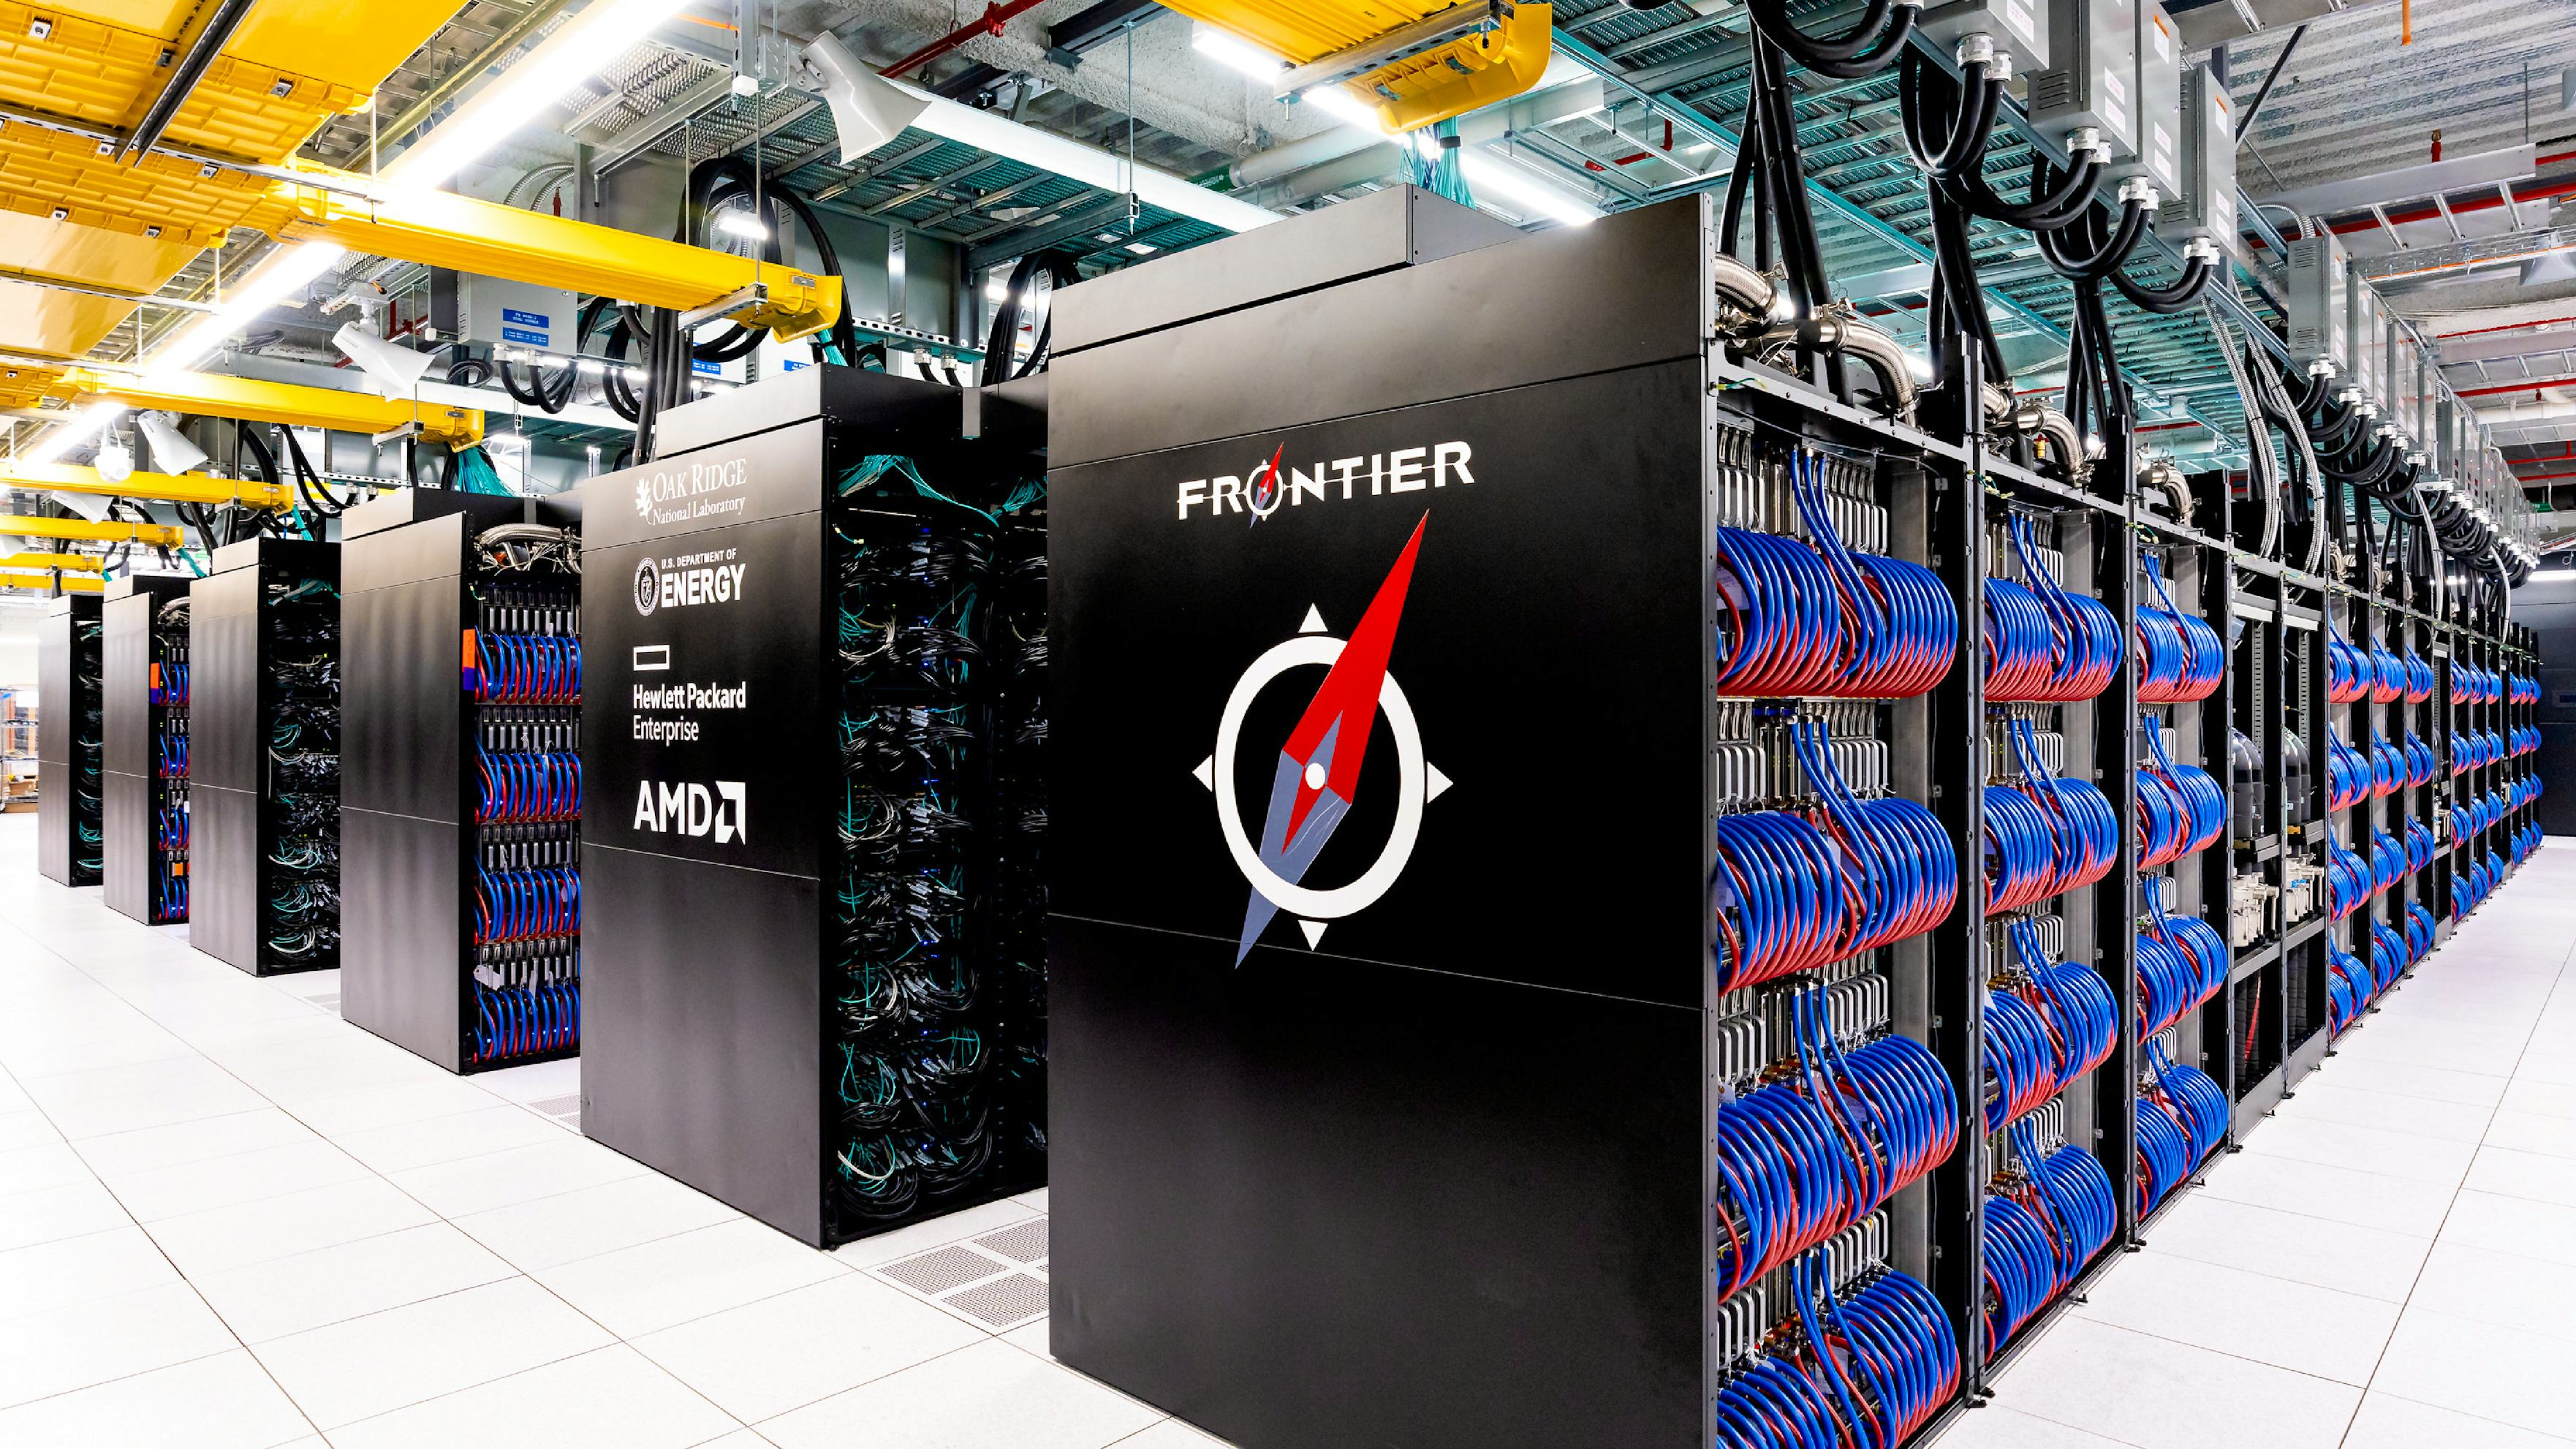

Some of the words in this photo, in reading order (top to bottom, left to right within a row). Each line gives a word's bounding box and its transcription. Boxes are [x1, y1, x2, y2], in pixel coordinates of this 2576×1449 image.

[1177, 440, 1475, 521] FRONTIER
[652, 502, 691, 526] National
[693, 496, 746, 518] Laboratory
[661, 558, 675, 570] U.S.
[677, 550, 724, 567] DEPARTMENT
[727, 548, 737, 560] OF
[661, 563, 746, 608] ENERGY
[633, 683, 686, 709] Hewlett
[687, 681, 746, 709] Packard
[633, 714, 700, 746] Enterprise
[633, 779, 713, 837] AMD
